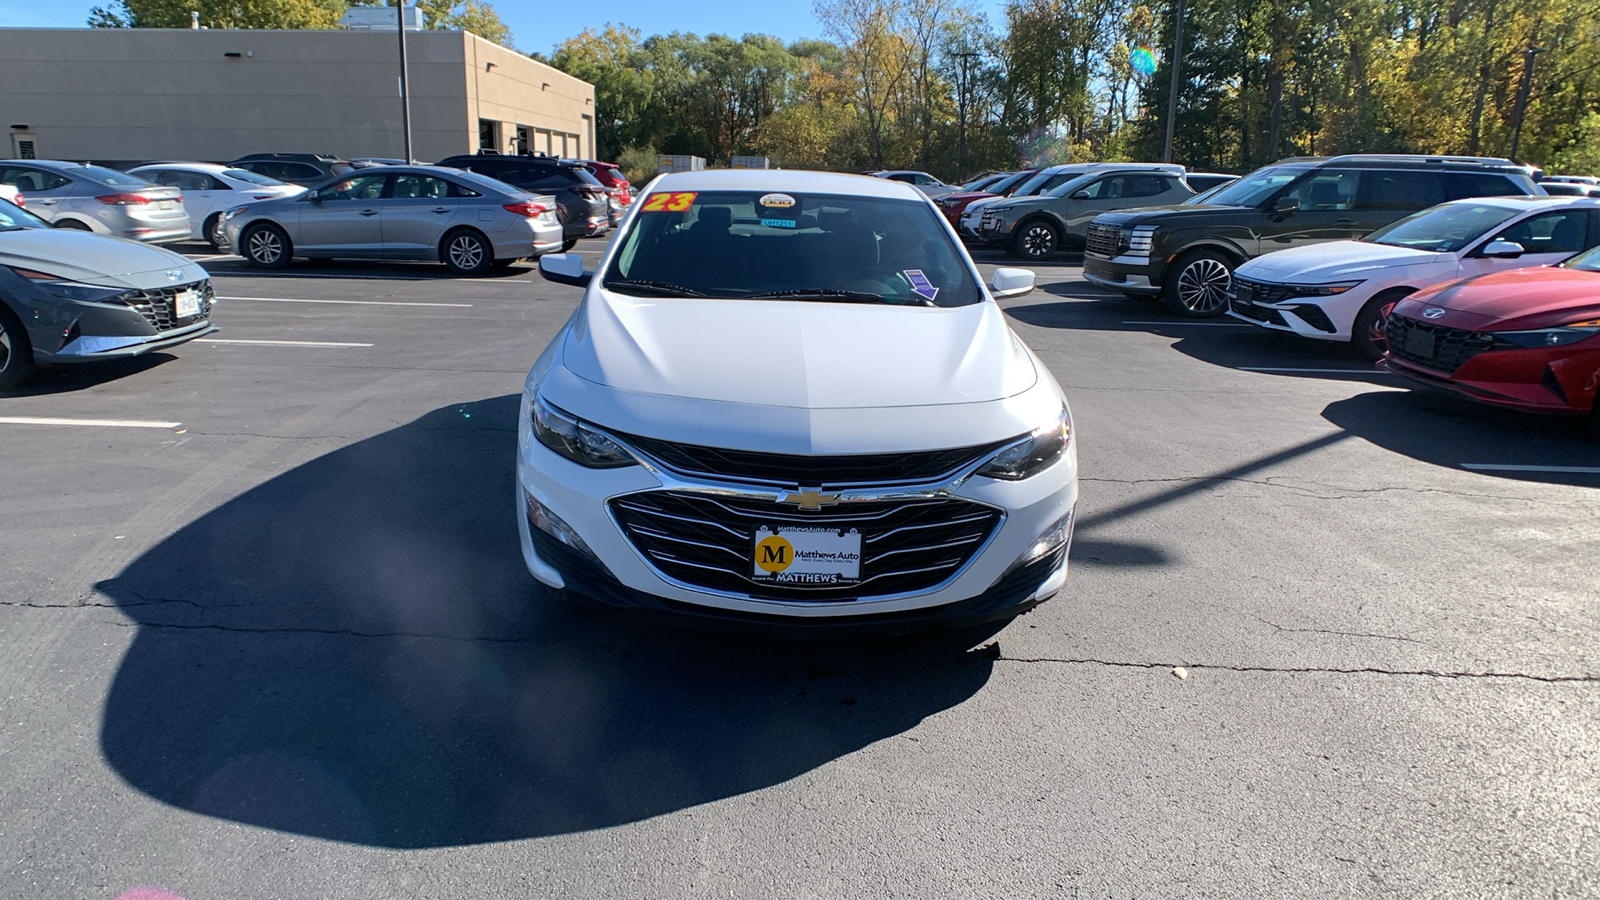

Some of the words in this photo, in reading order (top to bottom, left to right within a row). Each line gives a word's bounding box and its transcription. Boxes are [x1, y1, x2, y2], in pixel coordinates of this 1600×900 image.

[643, 192, 694, 212] 23
[760, 545, 787, 564] M
[794, 550, 836, 559] Matthews
[837, 551, 859, 560] Auto
[776, 573, 837, 583] MATTHEWS
